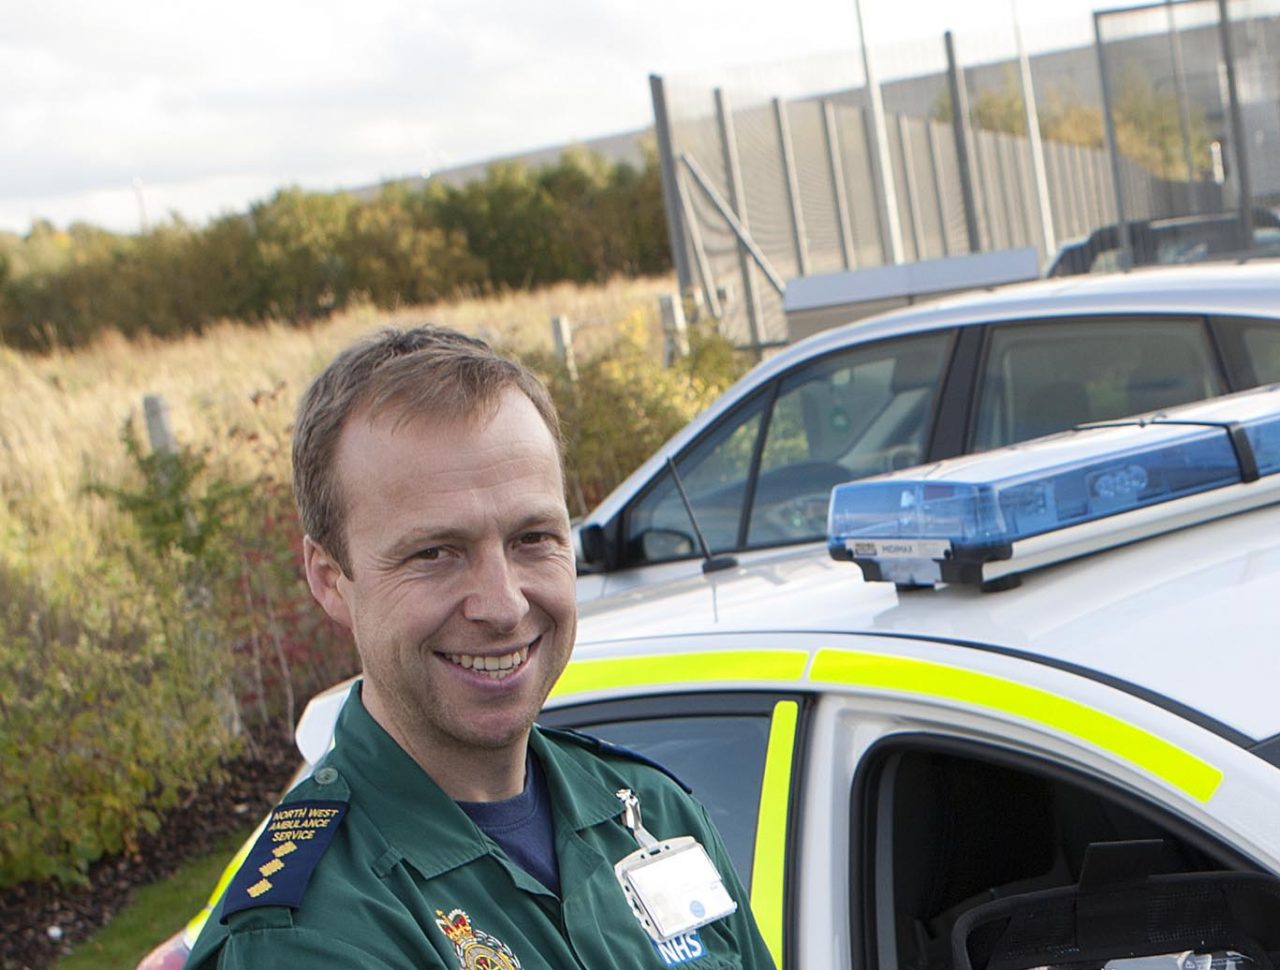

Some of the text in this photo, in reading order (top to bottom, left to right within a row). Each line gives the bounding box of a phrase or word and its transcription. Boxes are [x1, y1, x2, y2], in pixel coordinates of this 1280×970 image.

[272, 807, 339, 821] NORTH WEST
[267, 818, 331, 831] AMBULANCE
[271, 830, 316, 842] SERVICE
[658, 933, 702, 964] NHS
